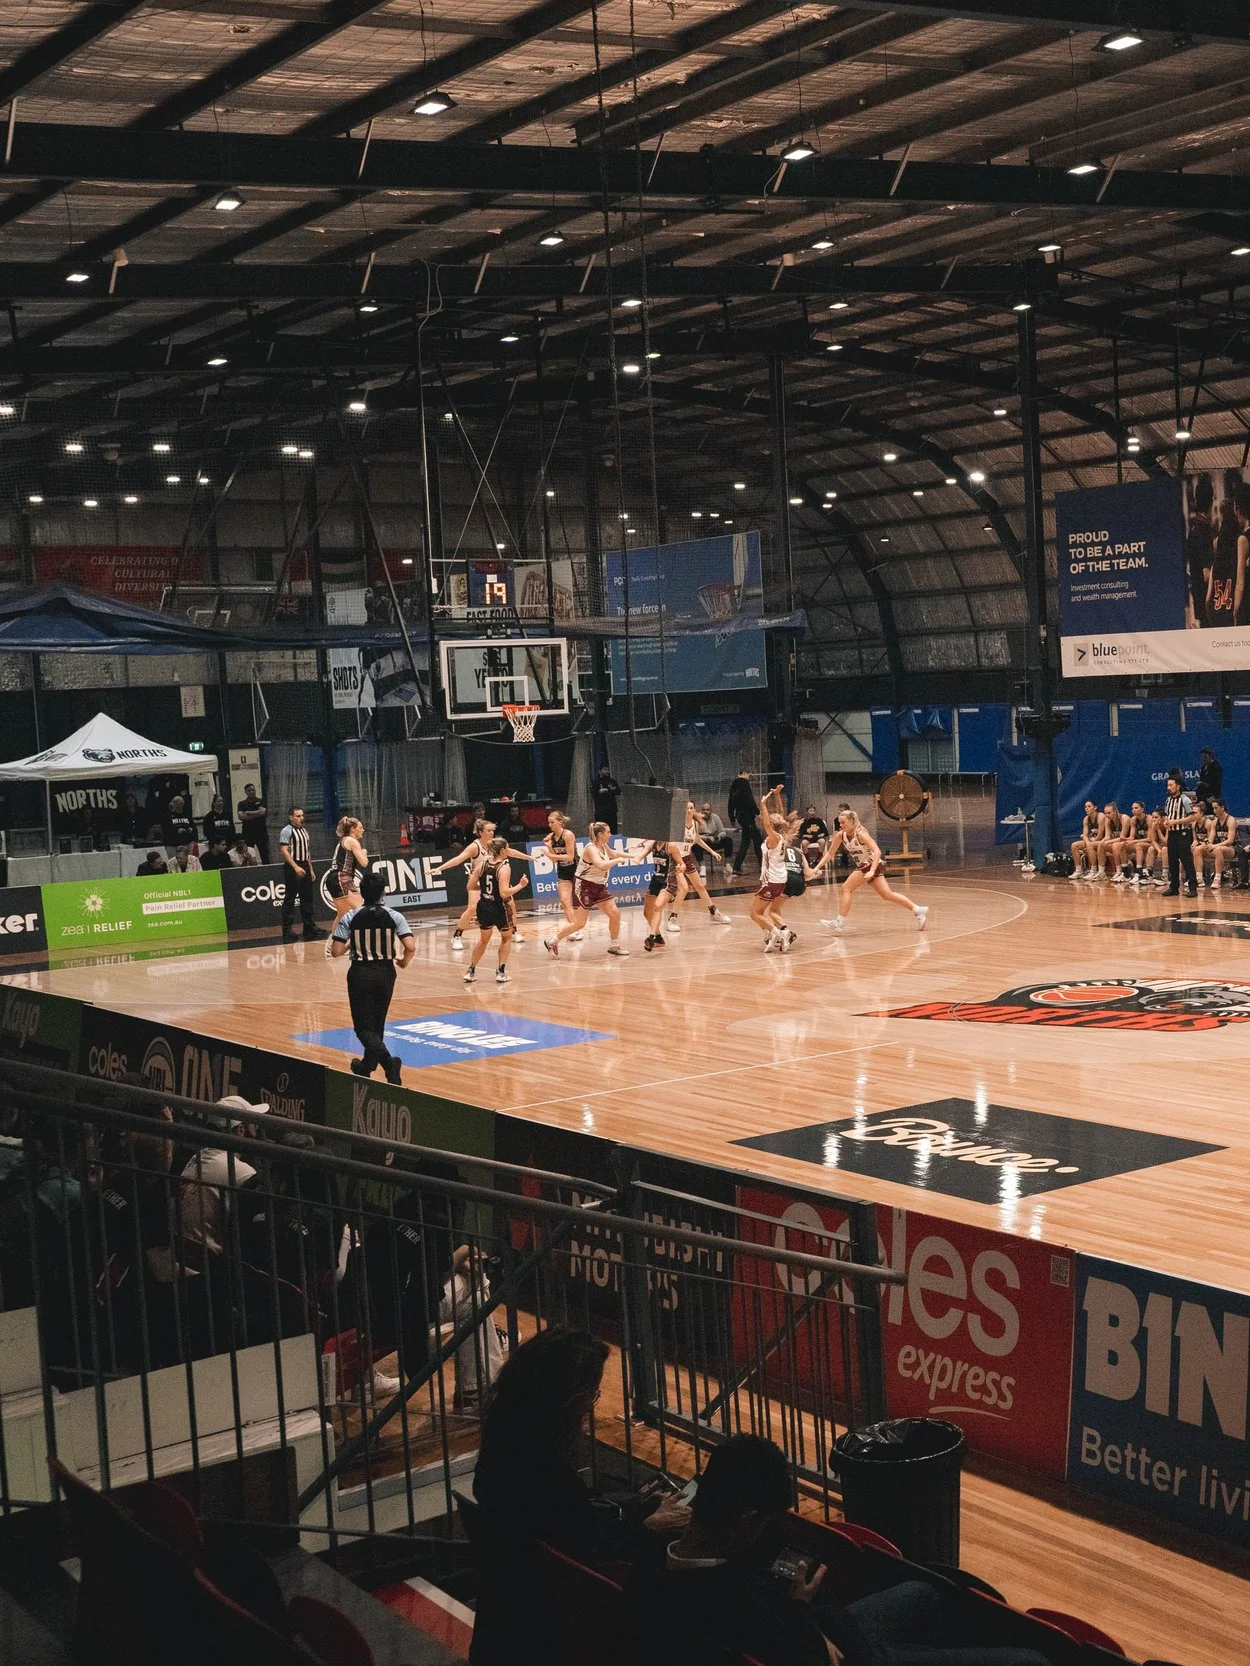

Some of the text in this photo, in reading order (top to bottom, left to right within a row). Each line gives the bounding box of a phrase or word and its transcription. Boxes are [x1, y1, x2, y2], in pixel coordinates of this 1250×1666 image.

[1068, 530, 1109, 545] PROUD
[1068, 541, 1147, 559] TO BE A PART
[90, 556, 168, 566] CELEBRATING
[1069, 556, 1149, 574] OF THE TEAM.
[114, 569, 170, 578] CULTURAL
[485, 582, 507, 605] 19
[1070, 580, 1129, 592] Investment consulting
[1214, 578, 1232, 610] 54
[1071, 594, 1082, 603] and
[1082, 593, 1101, 602] wealth
[629, 606, 642, 615] new
[642, 603, 659, 614] force
[1092, 641, 1150, 659] bluepoint
[1211, 640, 1233, 648] Contact
[332, 666, 359, 691] SHOTS
[118, 749, 169, 760] NORTHS
[1151, 769, 1202, 781] GRA SLA
[54, 788, 118, 816] NORTHS
[786, 847, 795, 862] 6
[485, 874, 493, 895] 5
[536, 881, 558, 894] Bett
[611, 874, 641, 885] every
[143, 888, 192, 900] Official NBL1
[241, 880, 287, 903] cole
[402, 894, 422, 904] EAST
[145, 898, 216, 912] Pain Relief Partner
[61, 920, 133, 936] zea RELIEF
[147, 919, 183, 928] zea.com.au
[886, 1002, 1250, 1032] NORTHS
[393, 1021, 487, 1039] BING
[456, 1033, 539, 1049] LEE
[88, 1041, 129, 1080] coles
[352, 1082, 413, 1165] Kayo
[839, 1117, 1080, 1174] Bounce.
[898, 1343, 1016, 1410] express
[1081, 1426, 1188, 1497] Better
